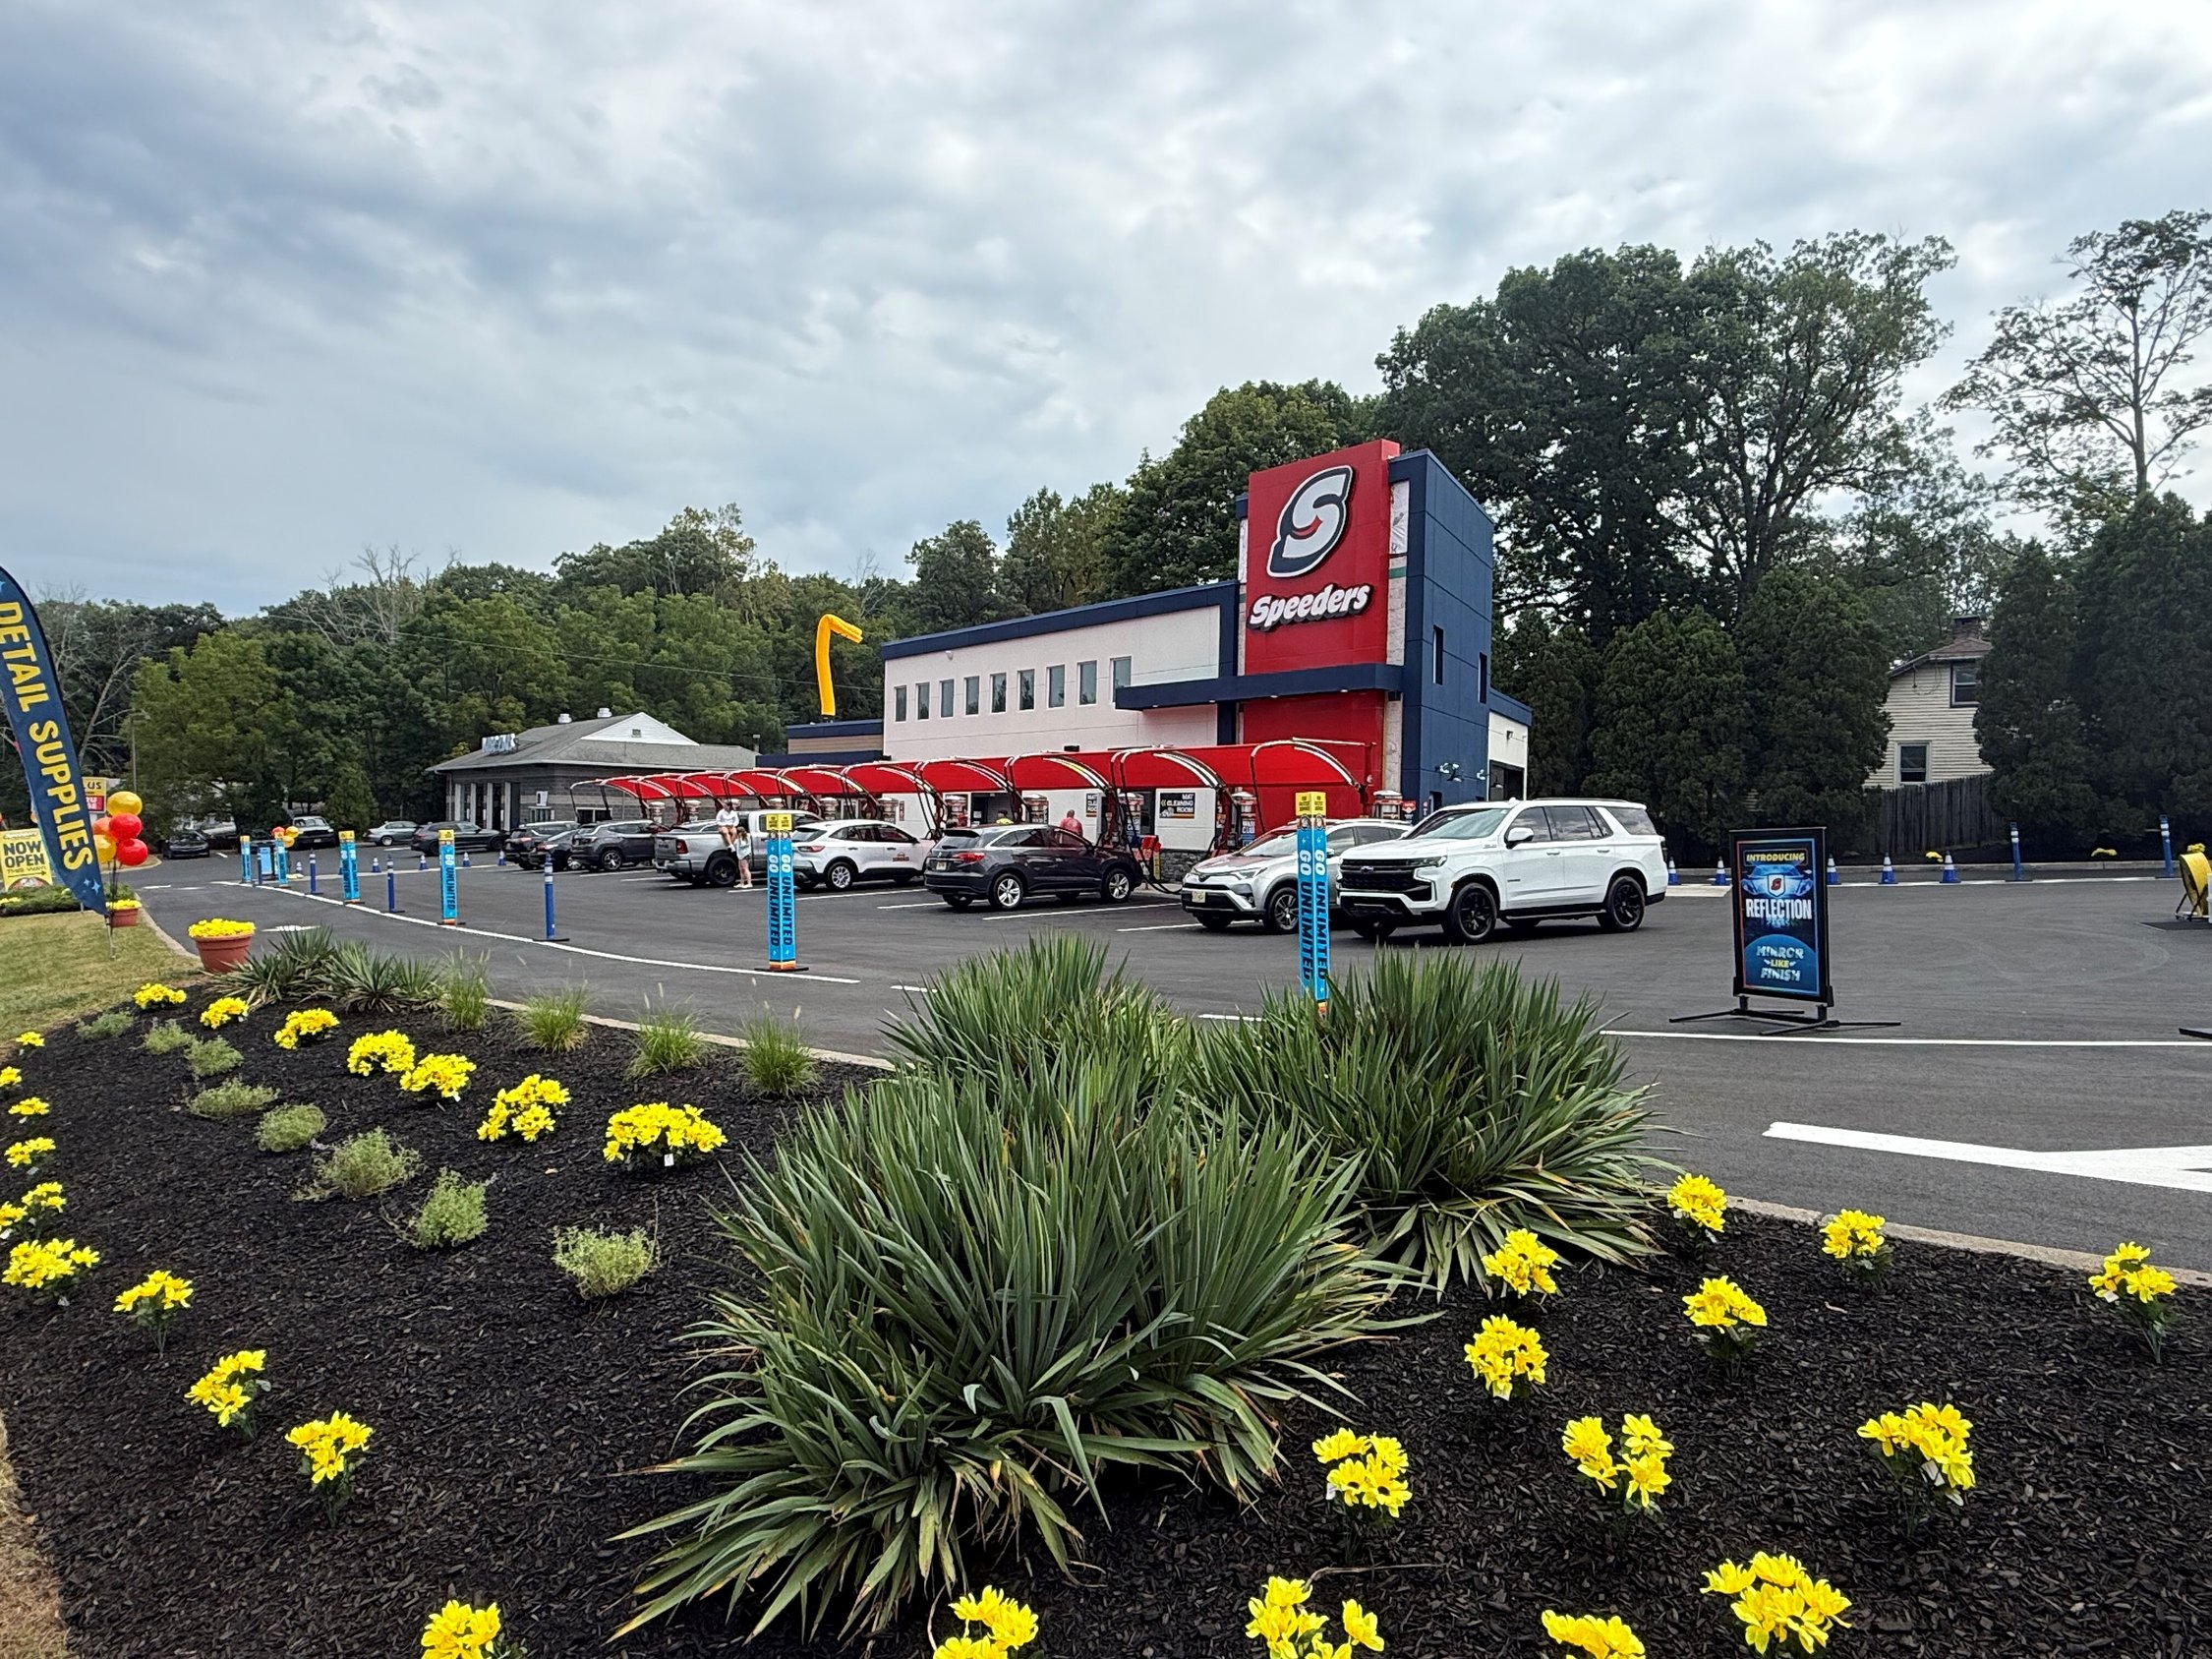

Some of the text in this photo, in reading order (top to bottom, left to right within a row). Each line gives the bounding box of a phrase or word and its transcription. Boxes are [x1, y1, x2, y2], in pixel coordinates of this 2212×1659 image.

[1249, 583, 1372, 630] Speeders
[0, 602, 93, 870] DETAIL SUPPLIES
[3, 841, 41, 856] NOW
[5, 854, 45, 867] OPEN
[1746, 853, 1805, 862] INTRODUCING
[444, 854, 456, 910] GO UNLIMITED
[769, 854, 781, 946] GO UNLIMITED
[782, 854, 792, 946] GO UNLIMITED
[1300, 850, 1314, 979] GO UNLIMITED
[1315, 849, 1327, 979] GO UNLIMITED
[1746, 898, 1812, 919] REFLECTION
[1761, 967, 1801, 981] FINISH
[1771, 959, 1789, 968] LIKE
